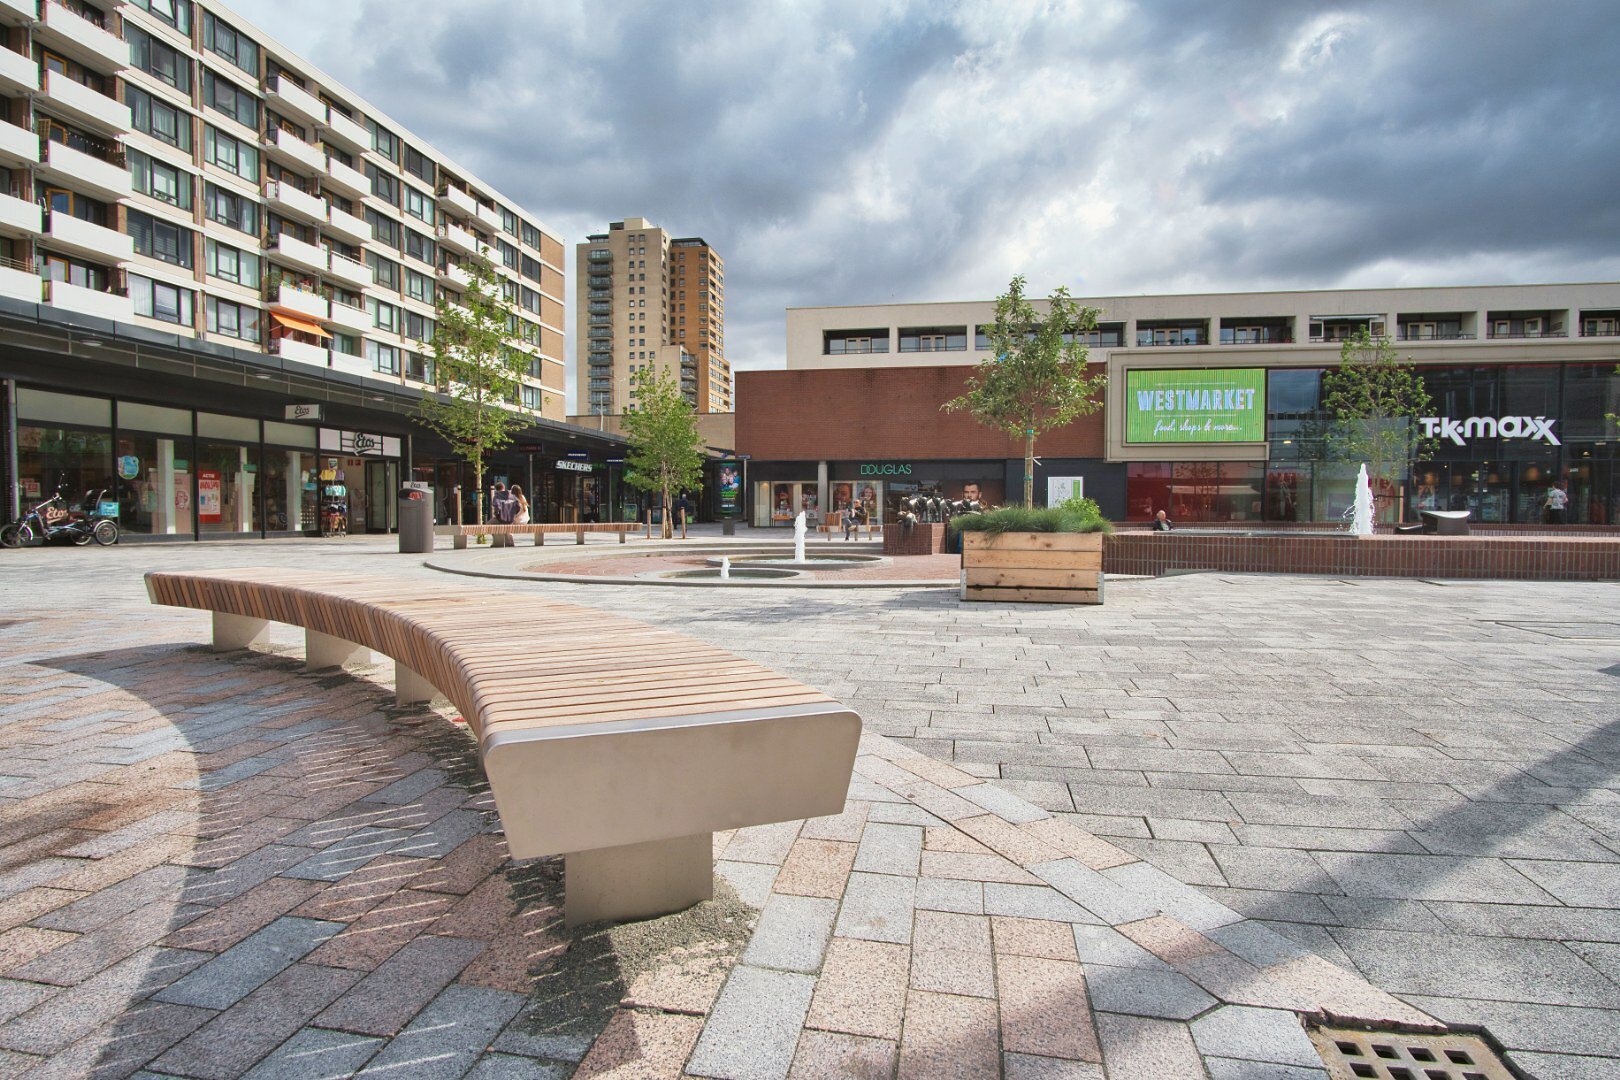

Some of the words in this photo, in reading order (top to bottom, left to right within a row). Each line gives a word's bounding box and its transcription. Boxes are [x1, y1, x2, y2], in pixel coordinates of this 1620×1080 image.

[1137, 389, 1255, 411] WESTMARKET
[294, 405, 310, 418] Etos
[1180, 419, 1202, 436] shops
[354, 433, 376, 456] Etos
[555, 460, 593, 472] SKECHERS
[860, 463, 912, 475] DOUGLAS
[46, 506, 68, 524] Etos
